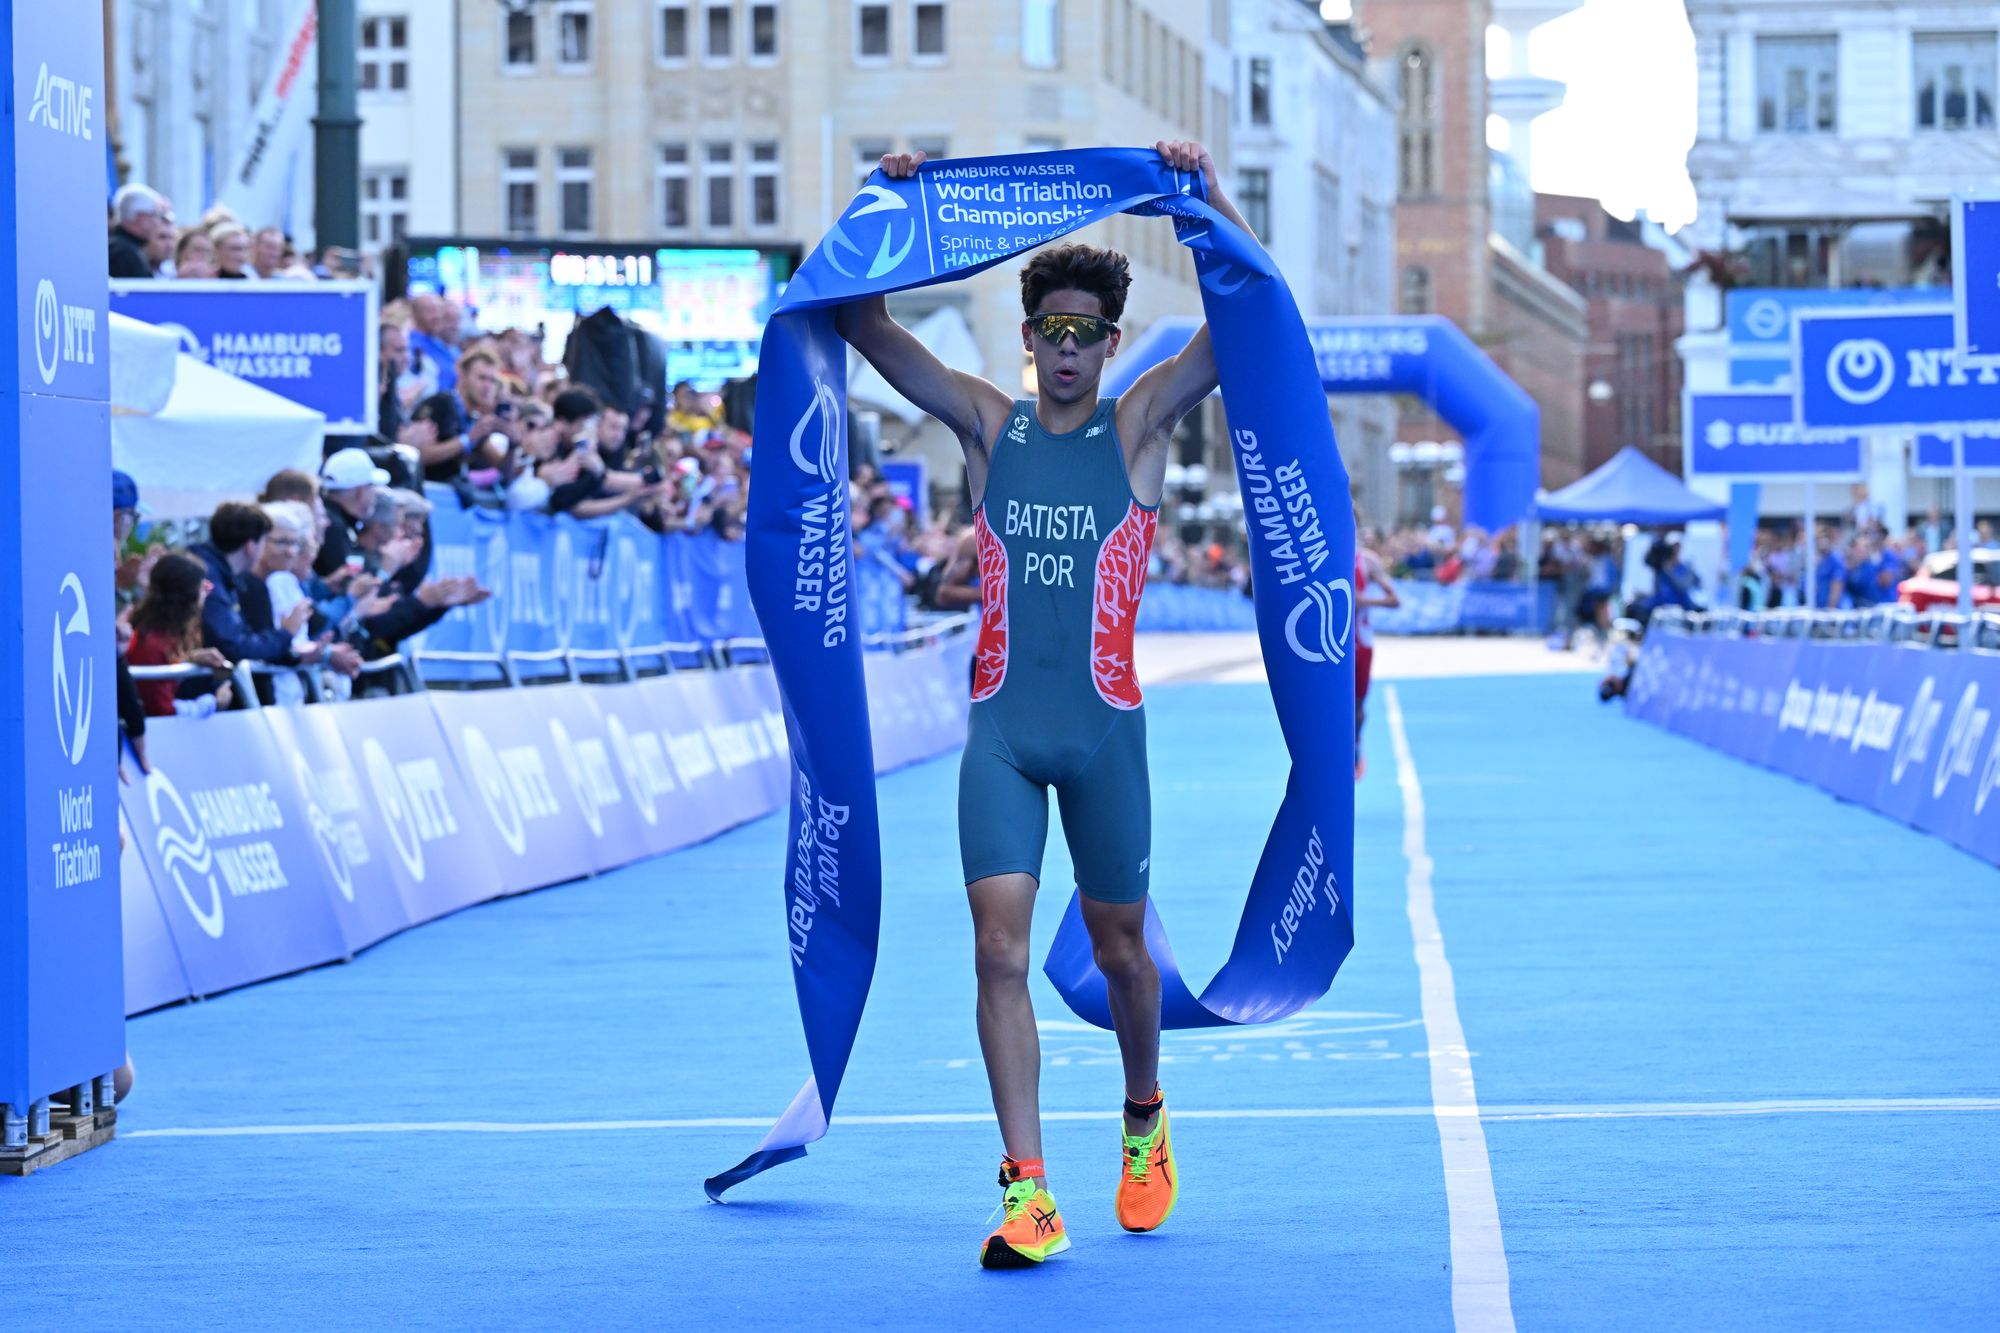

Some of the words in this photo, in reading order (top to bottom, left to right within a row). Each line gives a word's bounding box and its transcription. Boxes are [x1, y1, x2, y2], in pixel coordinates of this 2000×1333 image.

[28, 61, 92, 141] ACTIVE
[932, 165, 1010, 181] HAMBURG
[1012, 164, 1076, 176] WASSER
[935, 182, 1005, 202] World
[1008, 180, 1112, 203] Triathlon
[940, 234, 994, 252] Sprint
[997, 236, 1011, 250] &
[63, 304, 95, 365] NTT
[211, 331, 344, 357] HAMBURG
[212, 355, 313, 379] WASSER
[1005, 499, 1098, 541] BATISTA
[1235, 429, 1306, 585] HAMBURG
[1274, 458, 1330, 573] WASSER
[794, 493, 829, 612] WASSER
[823, 480, 847, 648] HAMBURG
[1024, 552, 1074, 588] POR
[59, 784, 92, 834] World
[189, 781, 284, 840] HAMBURG
[818, 795, 850, 841] Be
[52, 837, 100, 889] Triathlon
[213, 840, 288, 898] WASSER
[813, 829, 842, 909] your
